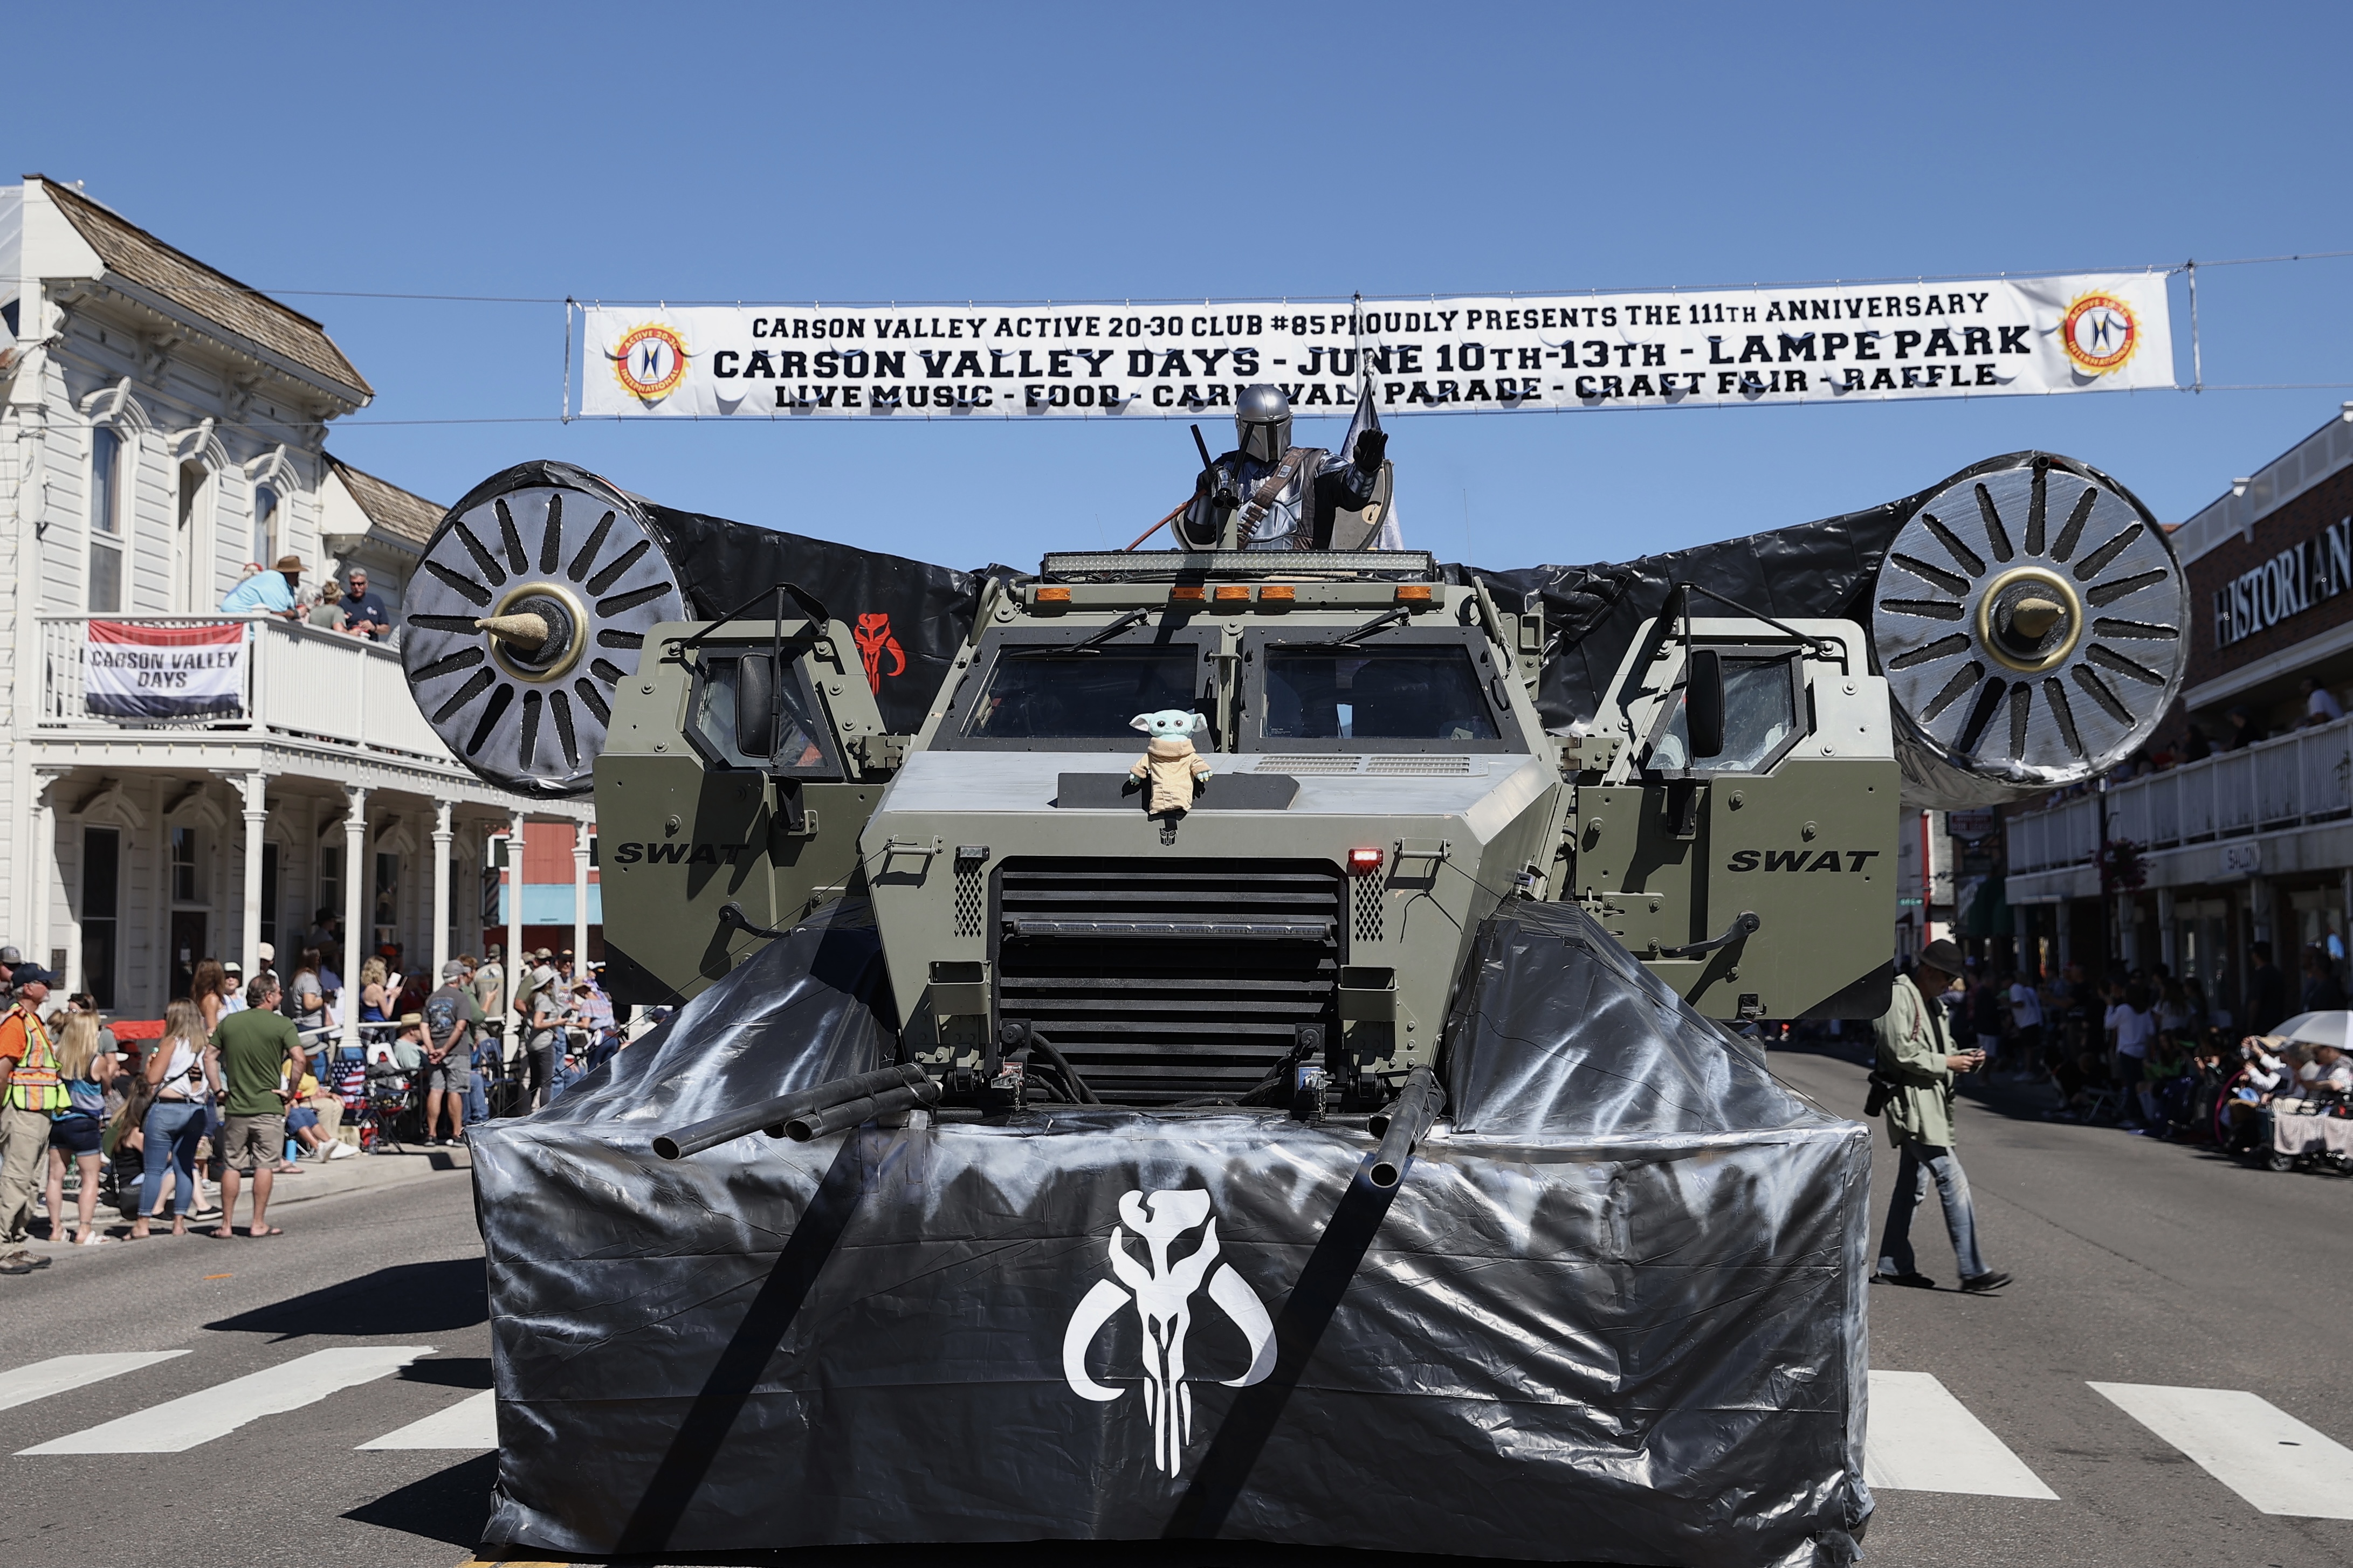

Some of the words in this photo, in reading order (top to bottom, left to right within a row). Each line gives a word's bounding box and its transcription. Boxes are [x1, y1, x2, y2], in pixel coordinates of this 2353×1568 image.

[752, 318, 866, 339] CARSON
[873, 317, 987, 339] VALLEY
[994, 316, 1100, 337] ACTIVE
[1108, 316, 1184, 337] 20-30
[1191, 315, 1262, 336] CLUB
[1467, 307, 1617, 330] PRESENTS
[1625, 305, 1681, 326] THE
[1689, 303, 1757, 324] 111TH
[1766, 293, 1989, 322] ANNIVERSARY
[624, 330, 653, 349] ACTIVE
[713, 349, 906, 378] CARSON
[919, 348, 1114, 378] VALLEY
[1127, 348, 1260, 377] DAYS
[1297, 345, 1423, 377] JUNE
[1436, 340, 1666, 371] 10TH-13TH
[1708, 330, 1880, 364] LAMPE
[1894, 325, 2031, 359] PARK
[621, 368, 679, 392] INTERNATIONAL
[775, 385, 862, 407] LIVE
[871, 385, 993, 408] MUSIC
[1025, 384, 1120, 407] FOOD
[1152, 383, 1356, 407] CARVAL
[1384, 377, 1542, 404] PARADE
[1575, 372, 1706, 399] CRAFT
[1717, 369, 1808, 395] FAIR
[1841, 363, 1997, 391] RAFFLE
[2211, 514, 2353, 651] HISTORIAN
[91, 651, 163, 669] CARSON
[171, 651, 239, 669] VALLEY
[137, 671, 187, 688] DAYS
[614, 842, 750, 865] SWAT
[1726, 850, 1880, 873] SWAT
